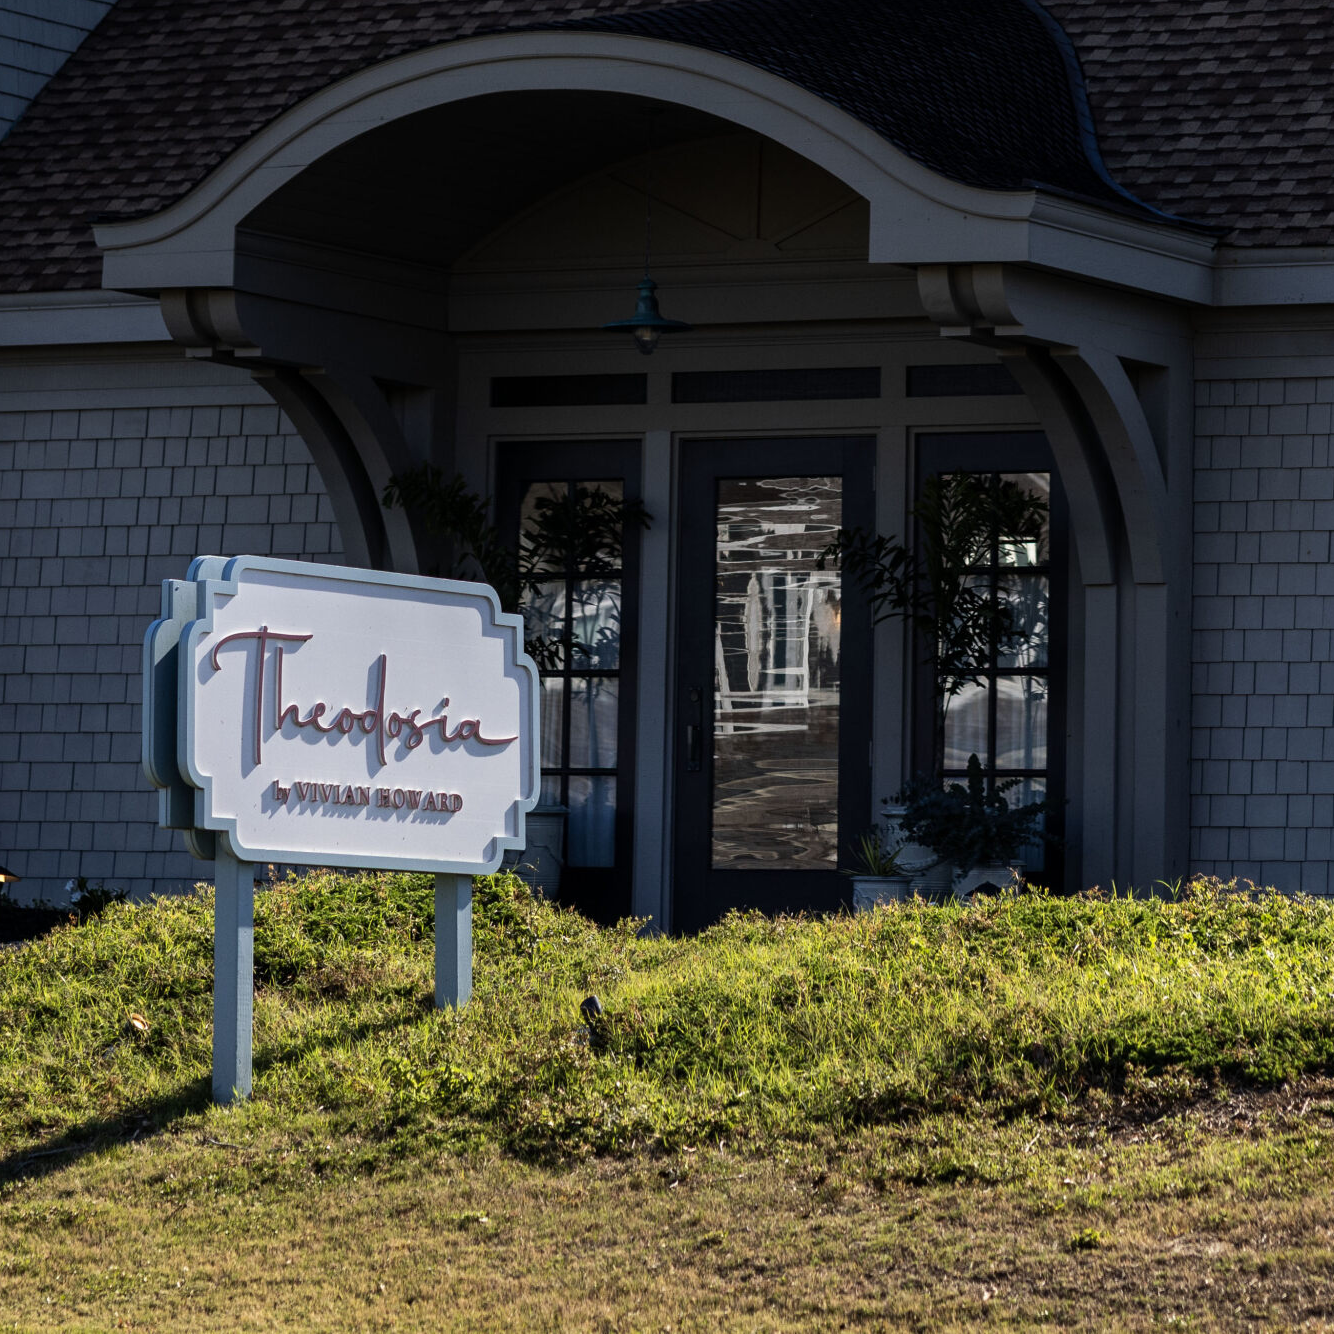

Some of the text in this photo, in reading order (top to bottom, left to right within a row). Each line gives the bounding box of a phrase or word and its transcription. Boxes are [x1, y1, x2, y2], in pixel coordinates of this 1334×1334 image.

[212, 625, 518, 765] Theodosia
[274, 780, 463, 813] by VIVIAN HOWARD
